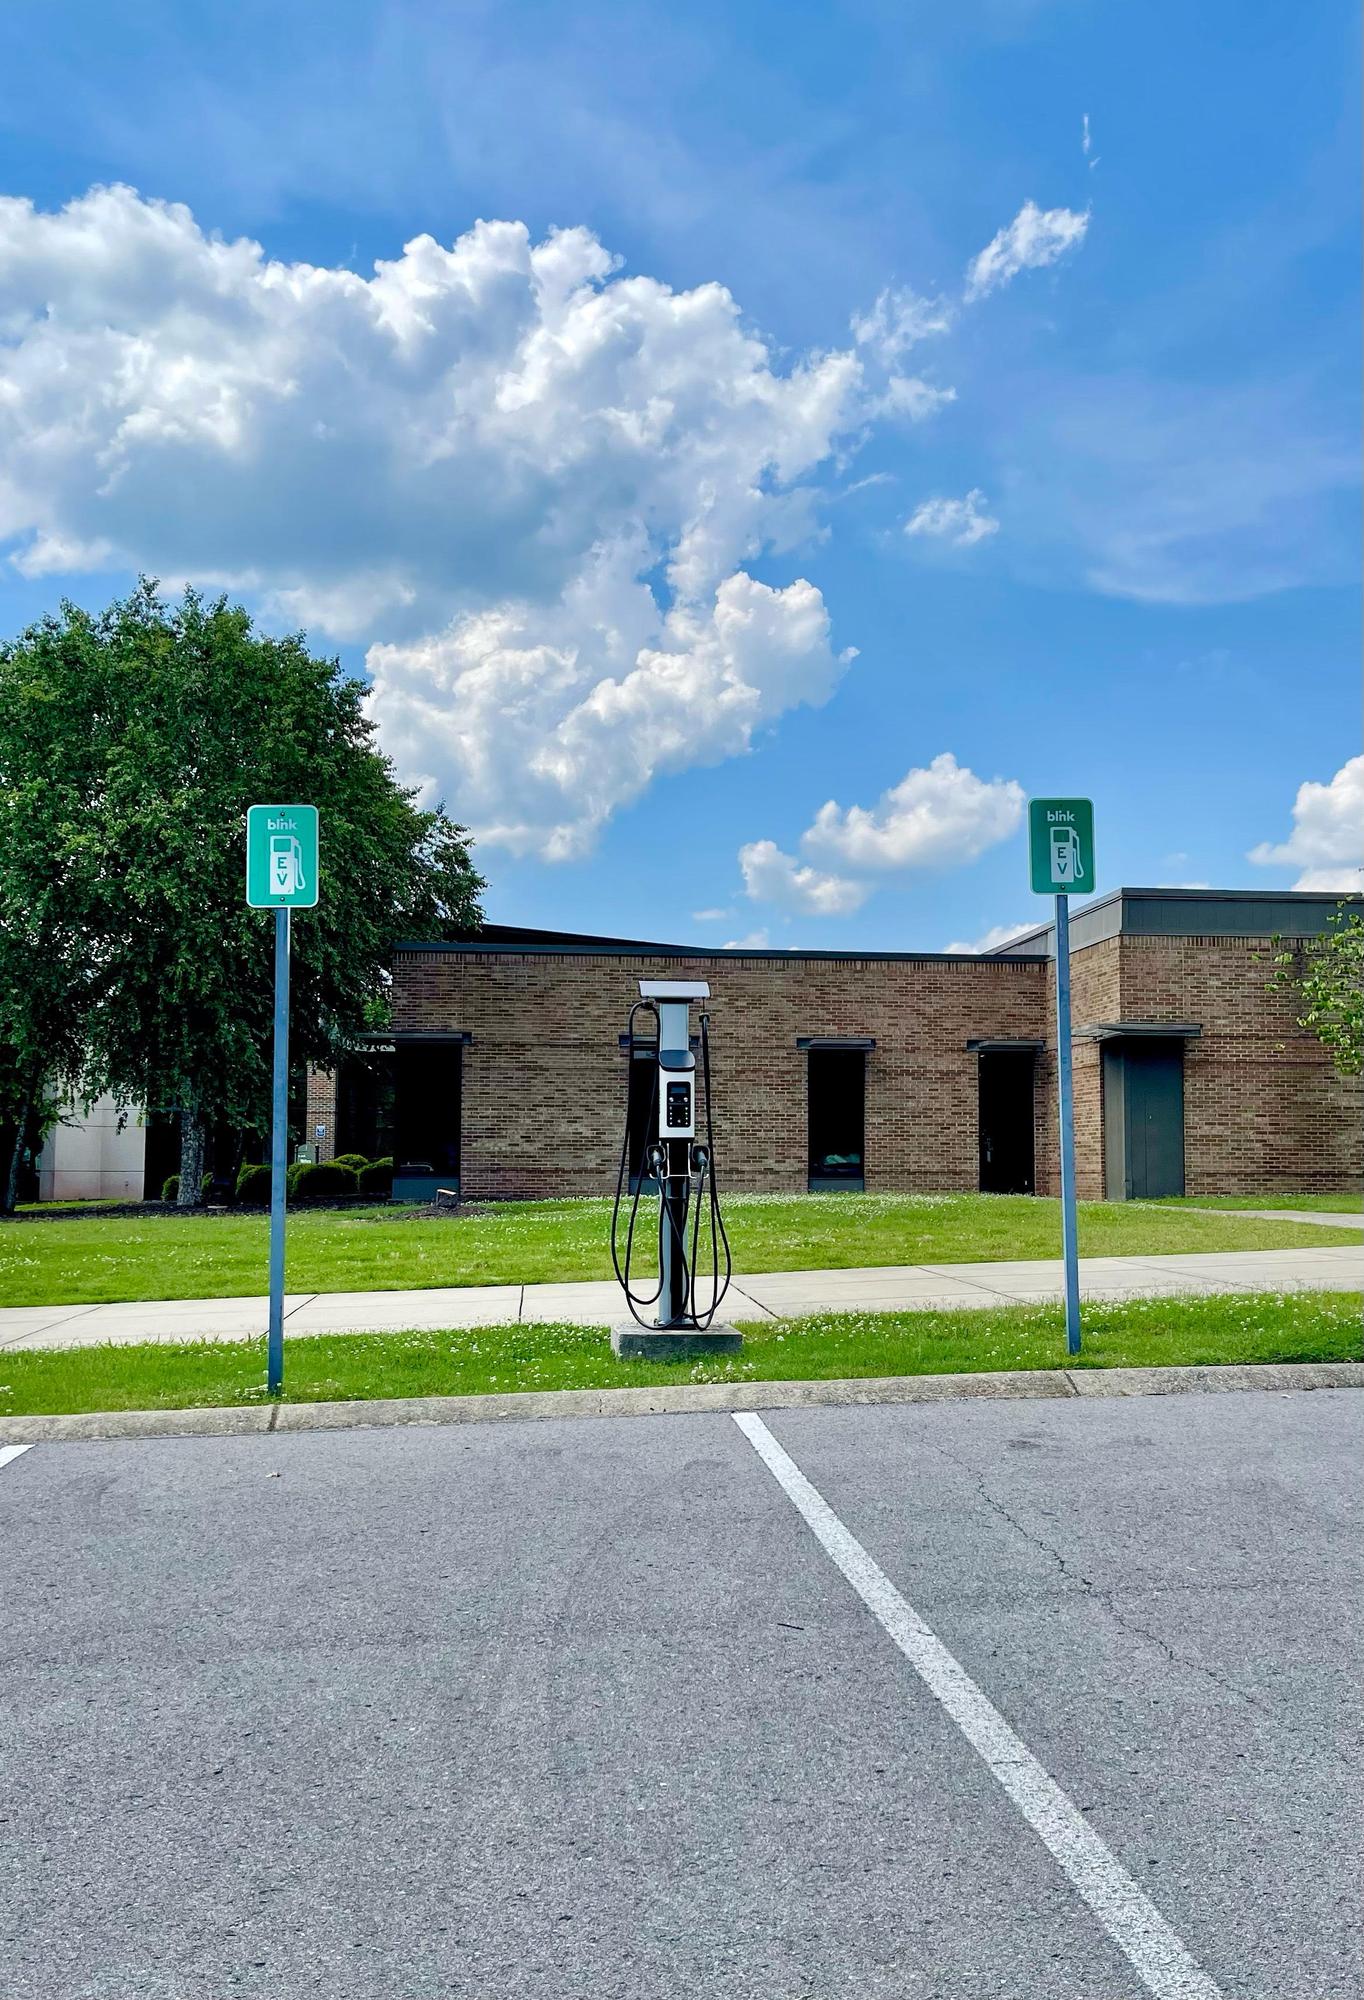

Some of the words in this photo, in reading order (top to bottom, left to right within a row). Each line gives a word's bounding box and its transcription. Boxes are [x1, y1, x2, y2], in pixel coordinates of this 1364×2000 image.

[267, 818, 297, 830] blink
[1047, 810, 1075, 821] blink
[1057, 847, 1067, 874] EV
[277, 857, 287, 886] EV
